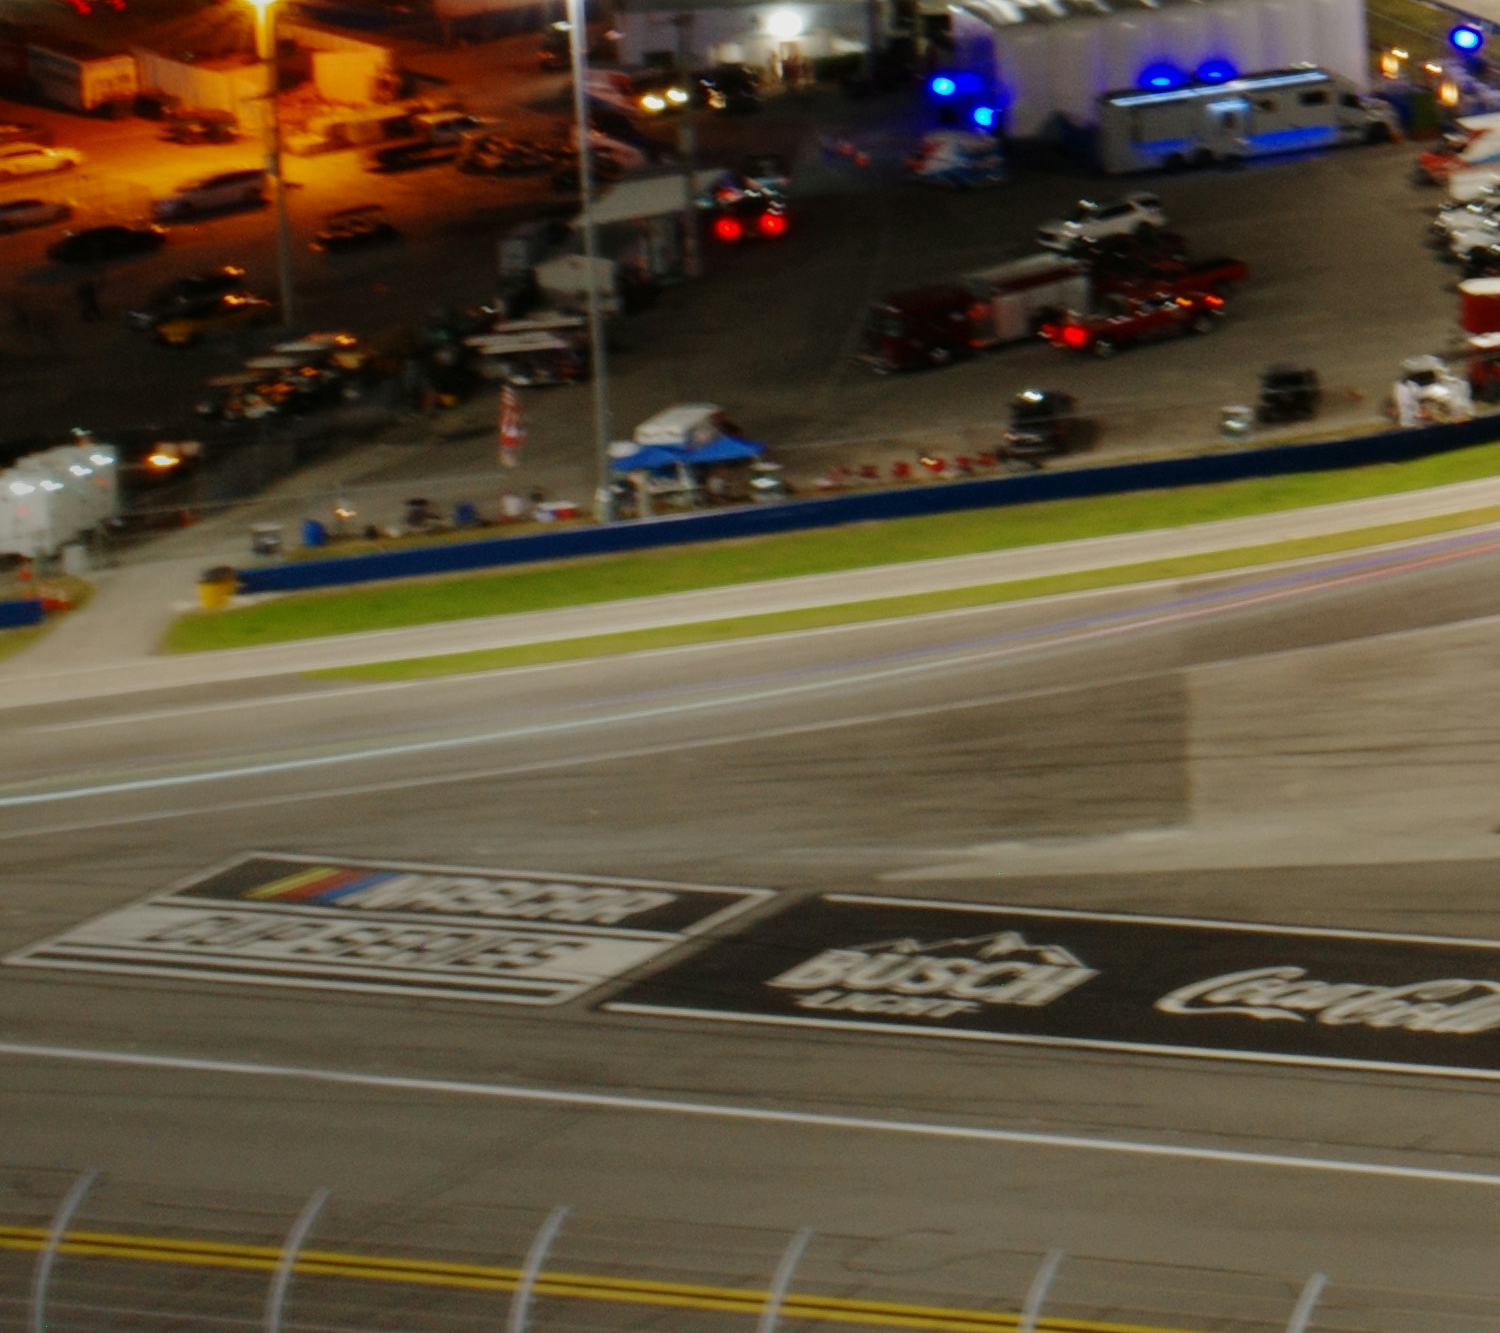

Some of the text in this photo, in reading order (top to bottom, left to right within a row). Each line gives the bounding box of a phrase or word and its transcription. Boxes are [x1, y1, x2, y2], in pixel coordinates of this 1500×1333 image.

[336, 873, 678, 924] NASCAR
[140, 916, 591, 971] CUP SERIES
[764, 948, 1101, 1007] BUSCH
[796, 990, 982, 1019] LIGHT
